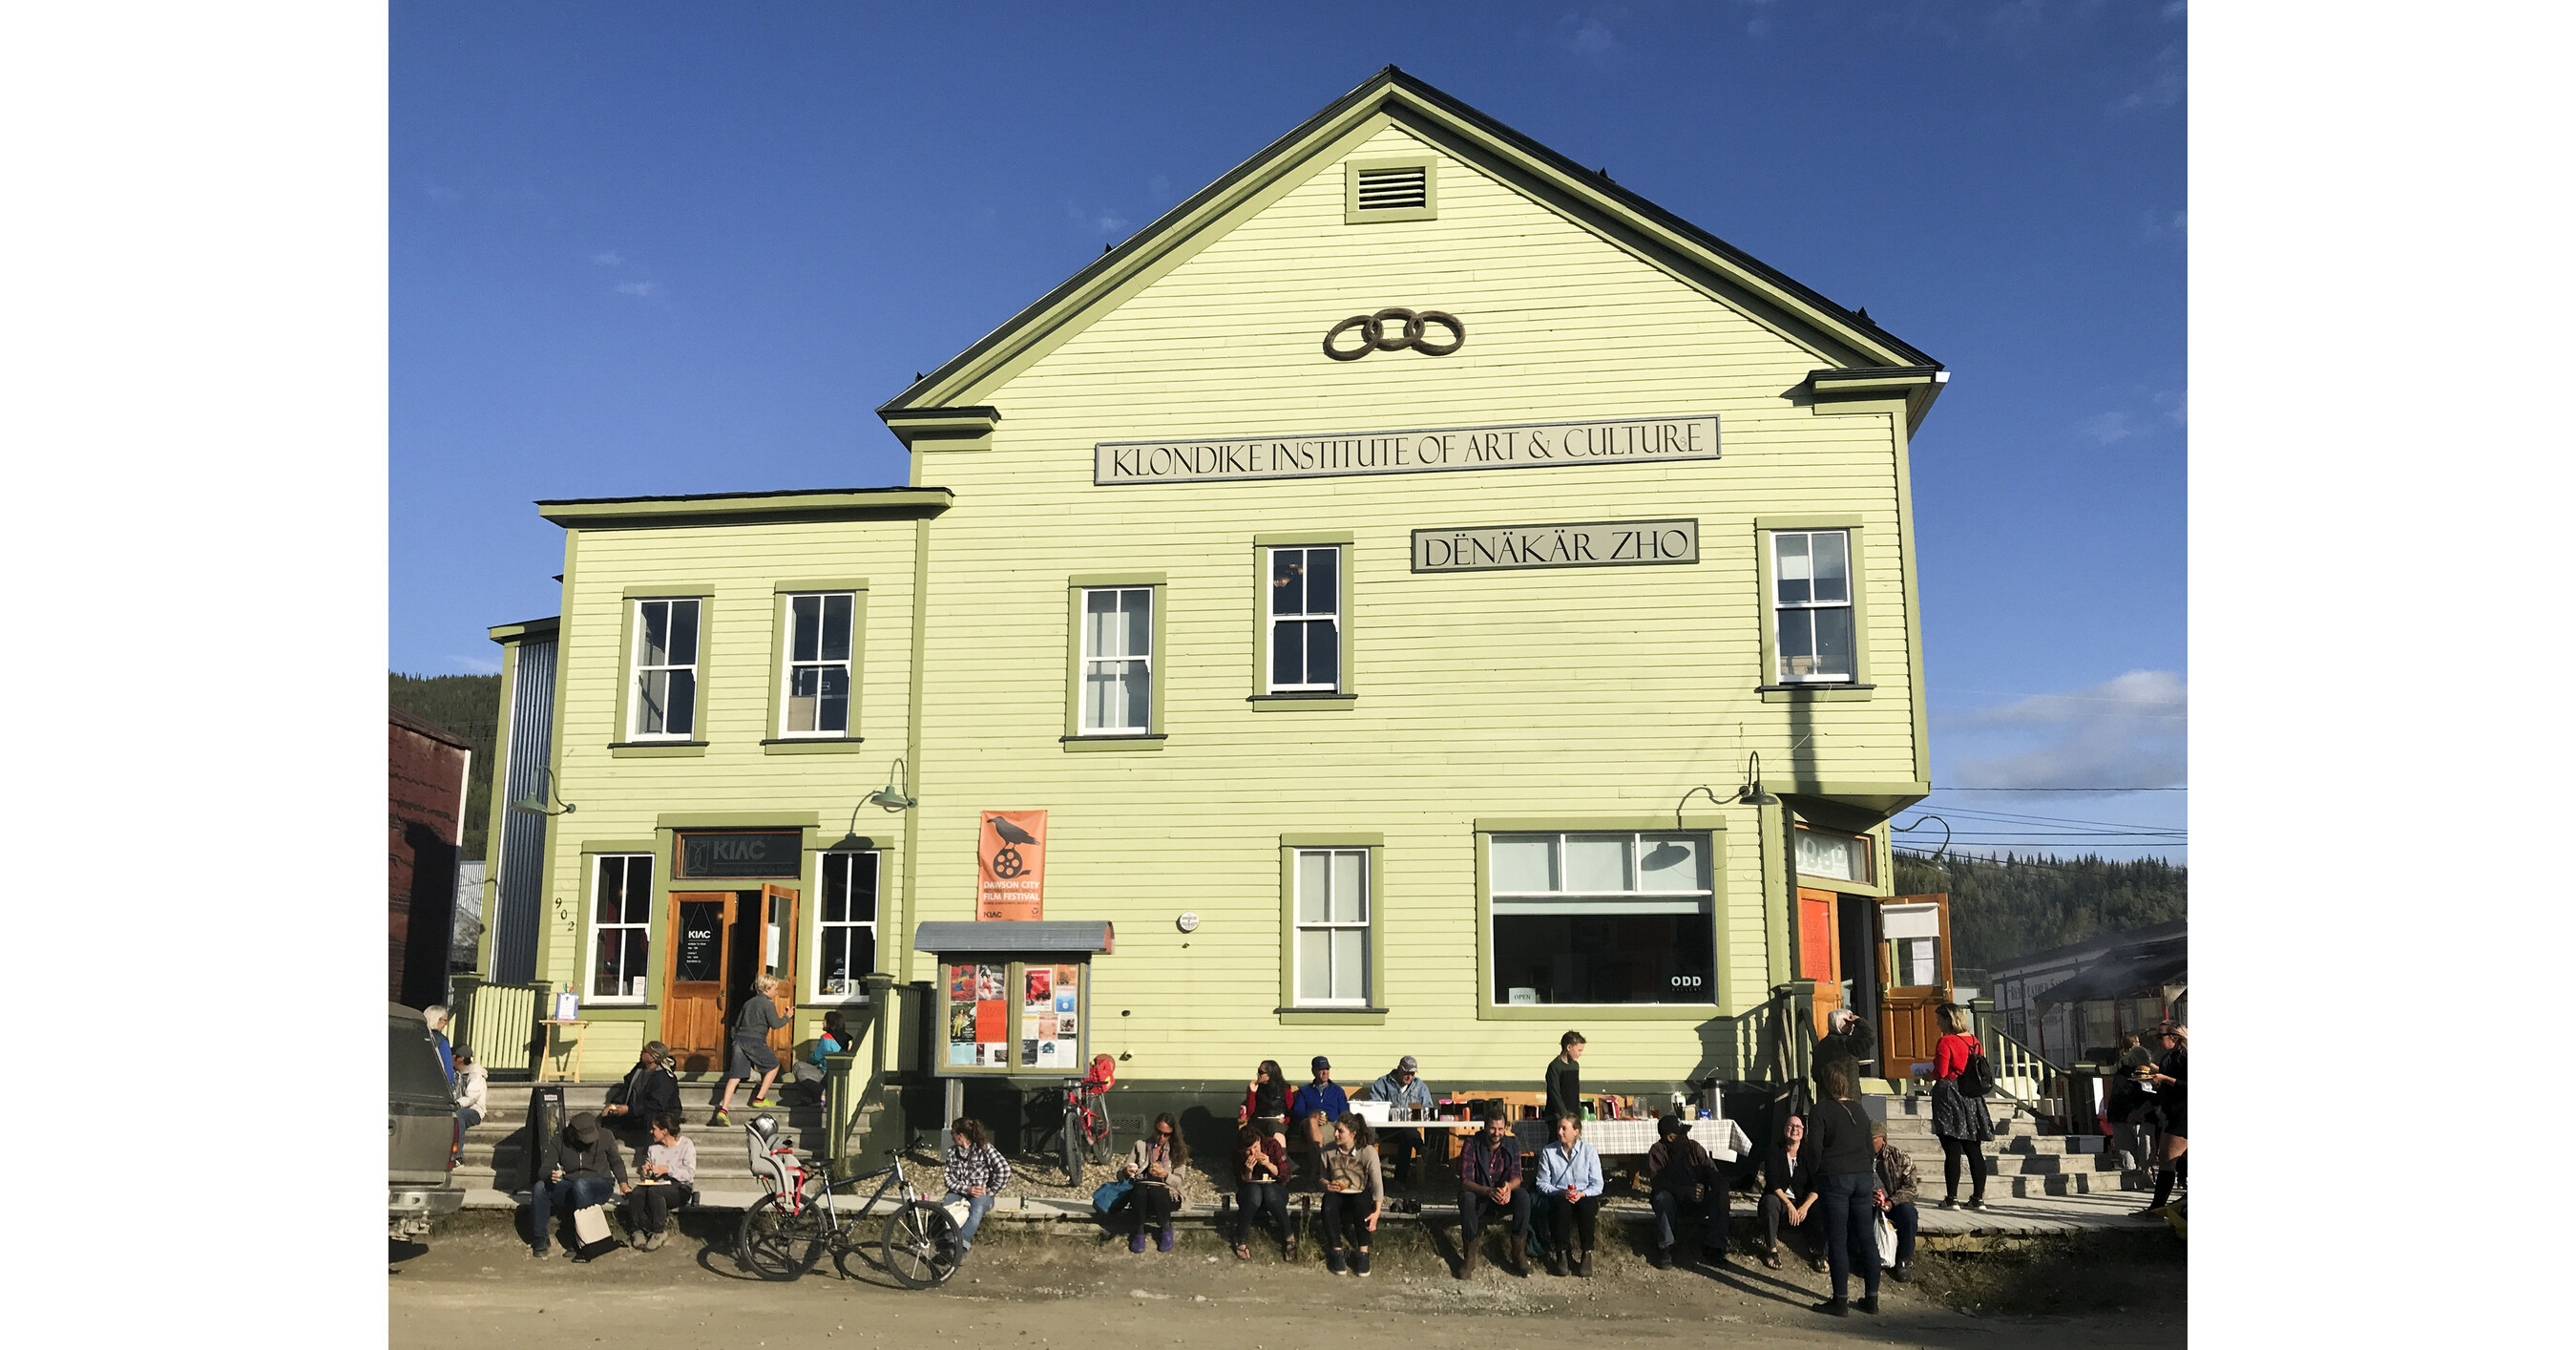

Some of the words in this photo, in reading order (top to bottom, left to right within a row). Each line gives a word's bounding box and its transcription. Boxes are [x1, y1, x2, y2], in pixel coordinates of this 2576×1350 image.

[1113, 444, 1264, 476] KLONDIKE
[1272, 437, 1410, 471] INSTITUTE
[1417, 434, 1456, 465] OF
[1465, 432, 1519, 462] ART
[1528, 431, 1555, 459] &
[1563, 423, 1704, 457] CULTURE
[1424, 529, 1600, 567] DËNÄKÄR
[1609, 529, 1688, 560] ZHO
[713, 840, 766, 860] KIAC
[1021, 880, 1040, 889] CITY
[1003, 892, 1040, 900] FESTIVAL
[688, 930, 711, 939] KIAC
[1671, 976, 1702, 987] ODD
